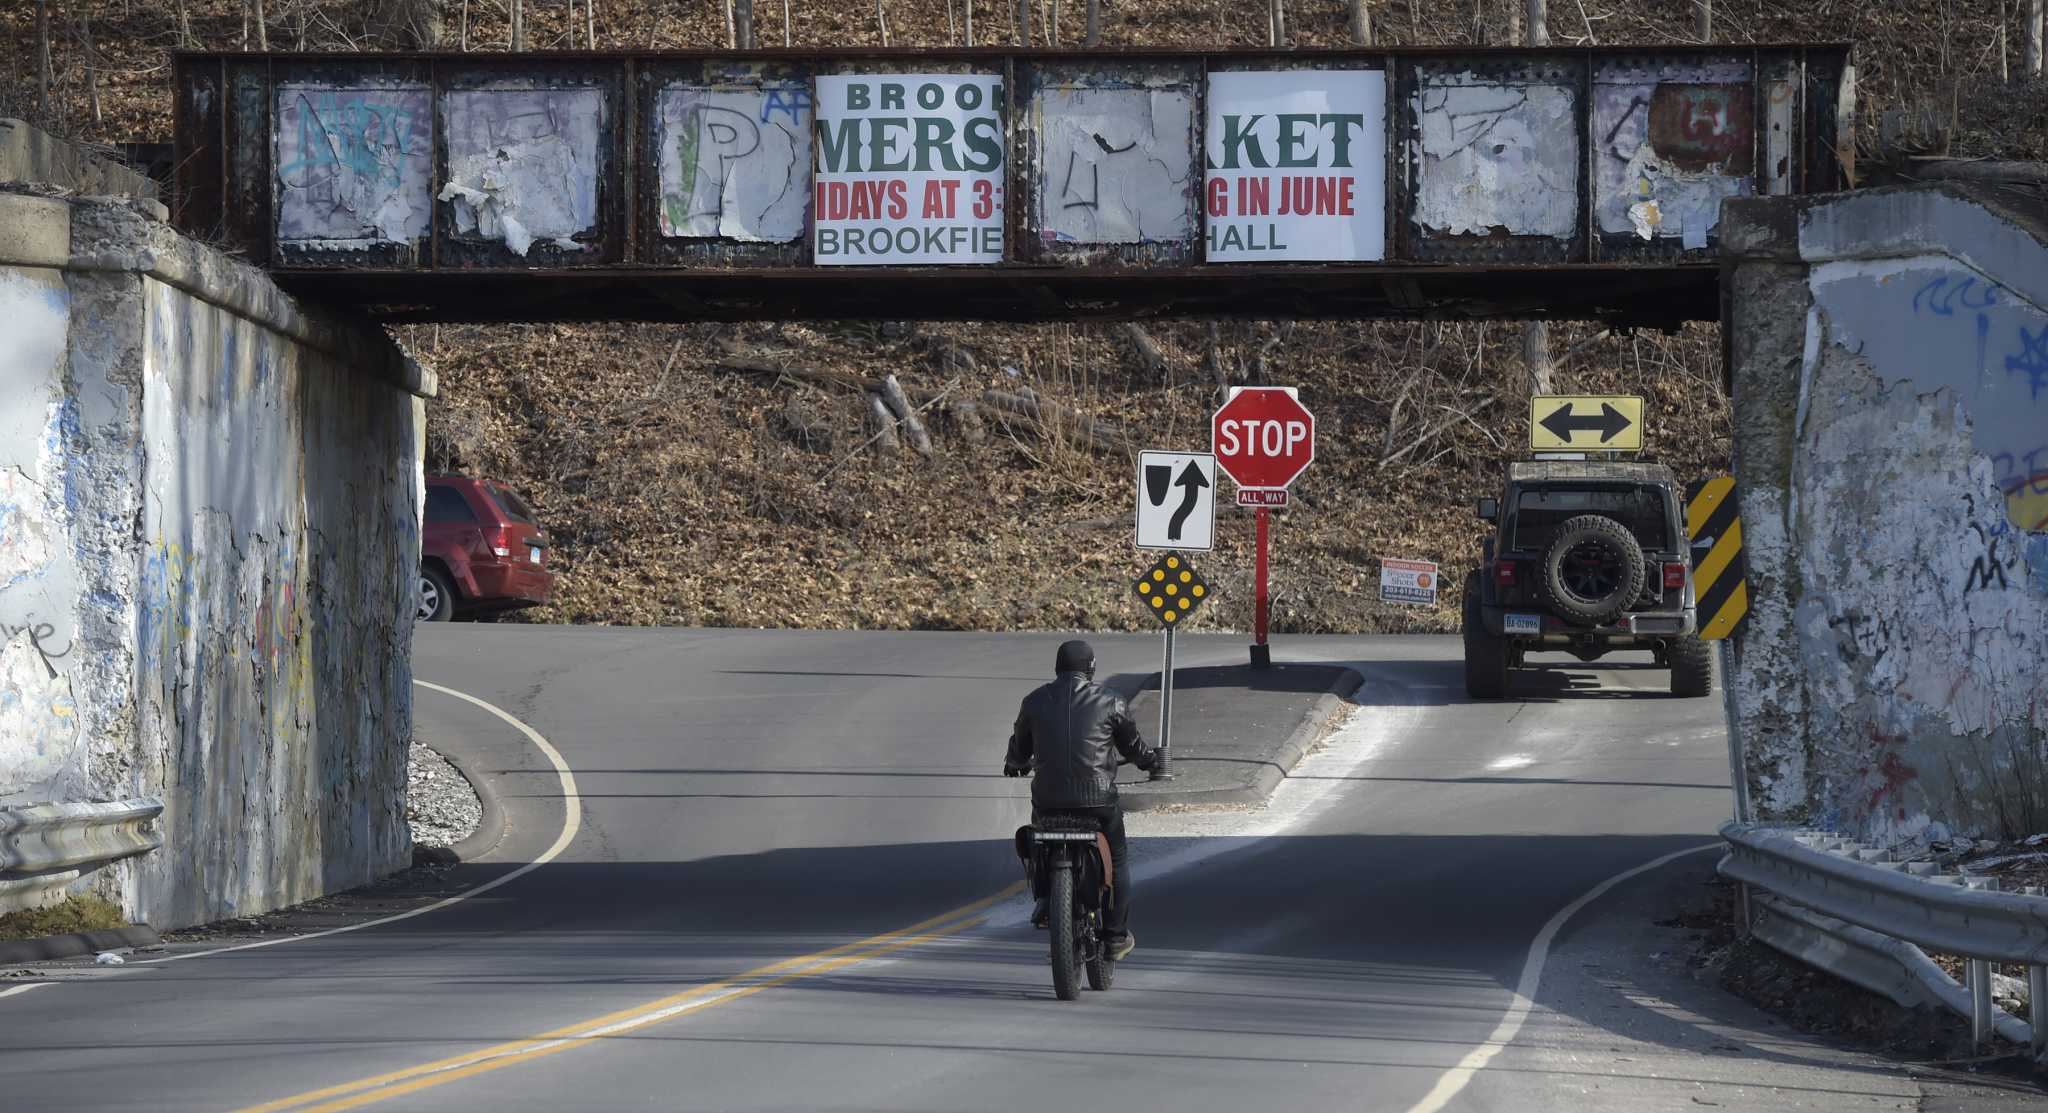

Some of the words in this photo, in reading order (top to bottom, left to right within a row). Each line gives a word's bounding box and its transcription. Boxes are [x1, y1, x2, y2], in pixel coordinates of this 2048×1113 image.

[816, 117, 1002, 173] MERS
[1207, 113, 1364, 169] KET
[922, 179, 961, 219] AT
[1237, 177, 1270, 216] IN
[1277, 176, 1355, 216] JUNE
[817, 227, 1002, 255] BROOKFIE
[1220, 419, 1307, 457] STOP
[1241, 492, 1259, 503] ALL
[1265, 492, 1284, 503] WAY
